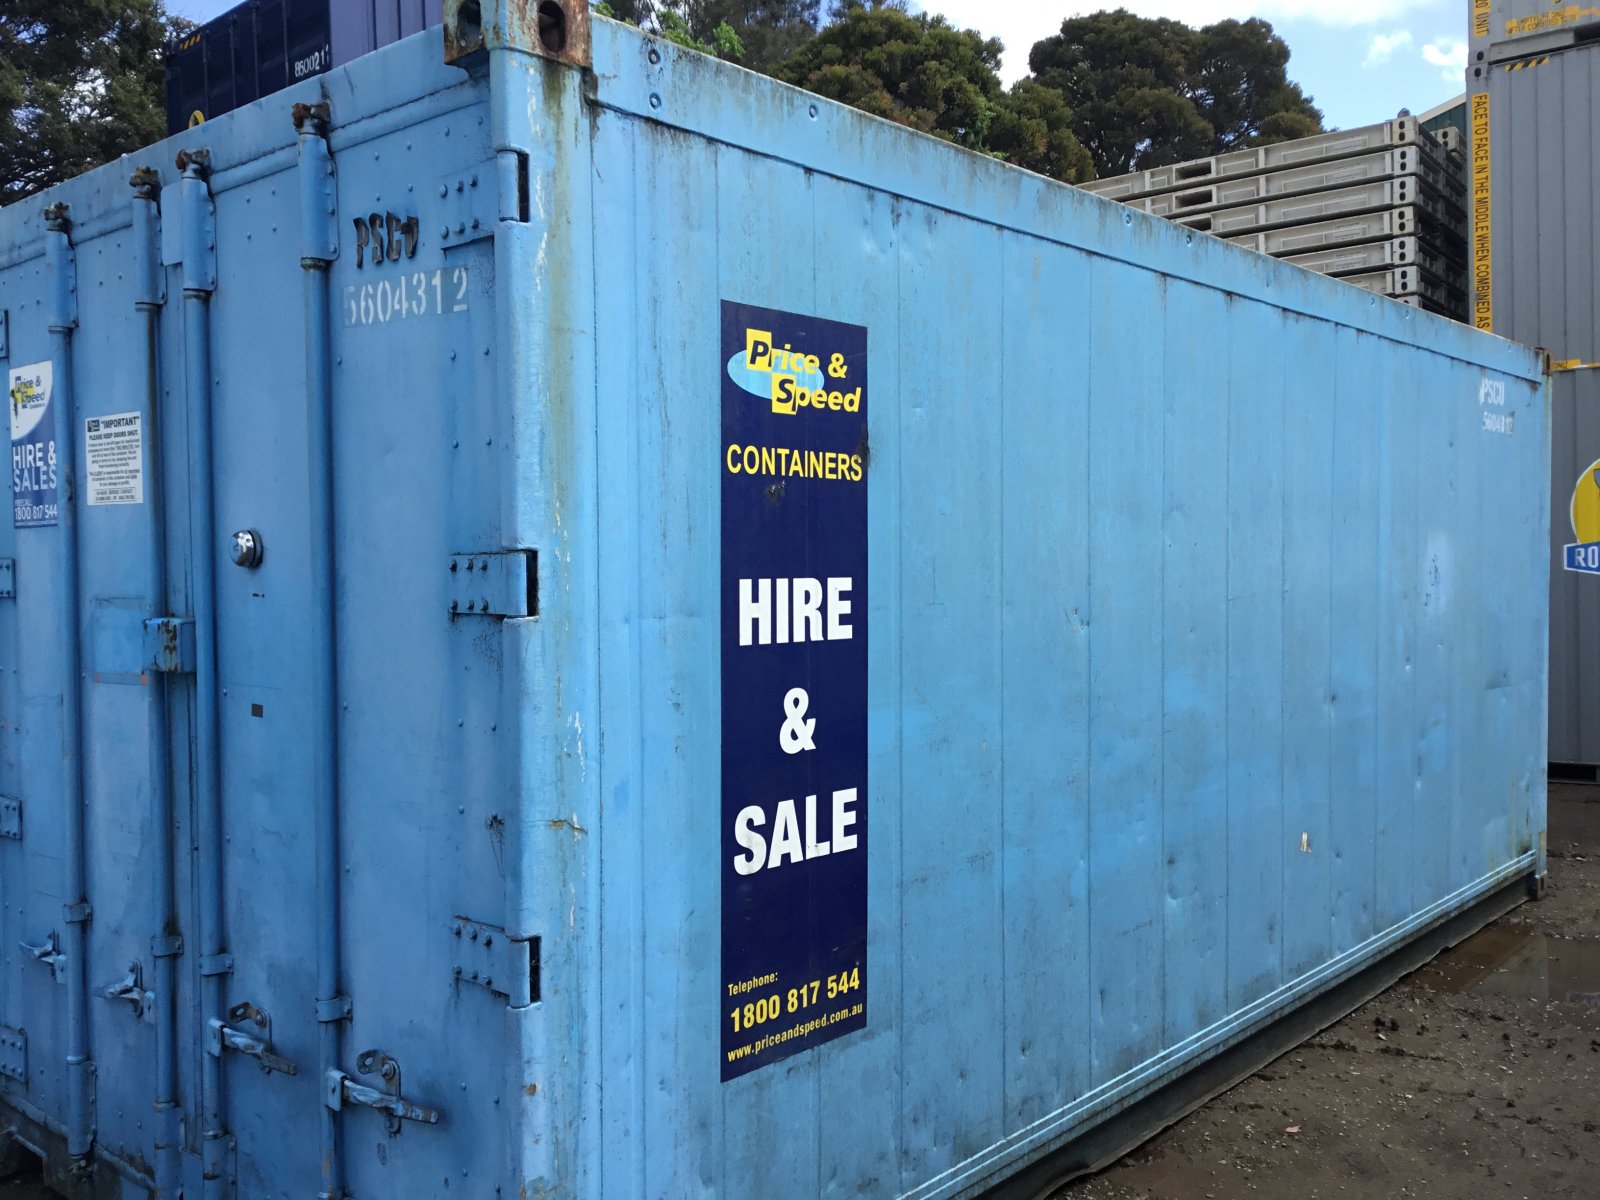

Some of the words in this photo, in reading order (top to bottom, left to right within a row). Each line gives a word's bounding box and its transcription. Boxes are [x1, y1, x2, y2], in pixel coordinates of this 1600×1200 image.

[1475, 11, 1490, 35] UNIT
[1474, 94, 1488, 120] FACE
[1474, 121, 1488, 136] TO
[1475, 137, 1488, 162] FACE
[1475, 163, 1488, 174] IN
[1475, 175, 1489, 195] THE
[1475, 196, 1489, 232] MIDDLE
[1475, 233, 1489, 261] WHEN
[344, 267, 467, 326] 5604312
[1476, 263, 1490, 314] COMBINED
[1476, 316, 1490, 329] AS
[748, 337, 820, 375] Price
[827, 352, 848, 379] &
[775, 378, 862, 414] Speed
[13, 443, 43, 470] HIRE
[48, 441, 57, 465] &
[726, 443, 862, 482] CONTAINERS
[13, 466, 57, 492] SALES
[15, 506, 32, 520] 1800
[32, 505, 43, 519] 817
[44, 503, 58, 518] 544
[738, 577, 853, 647] HIRE
[779, 687, 817, 755] &
[733, 787, 858, 876] SALE
[727, 971, 779, 997] Telephone:
[730, 994, 781, 1033] 1800
[787, 980, 821, 1013] 817
[827, 967, 860, 999] 544
[727, 1002, 863, 1063] www.priceandspeed.com.au
